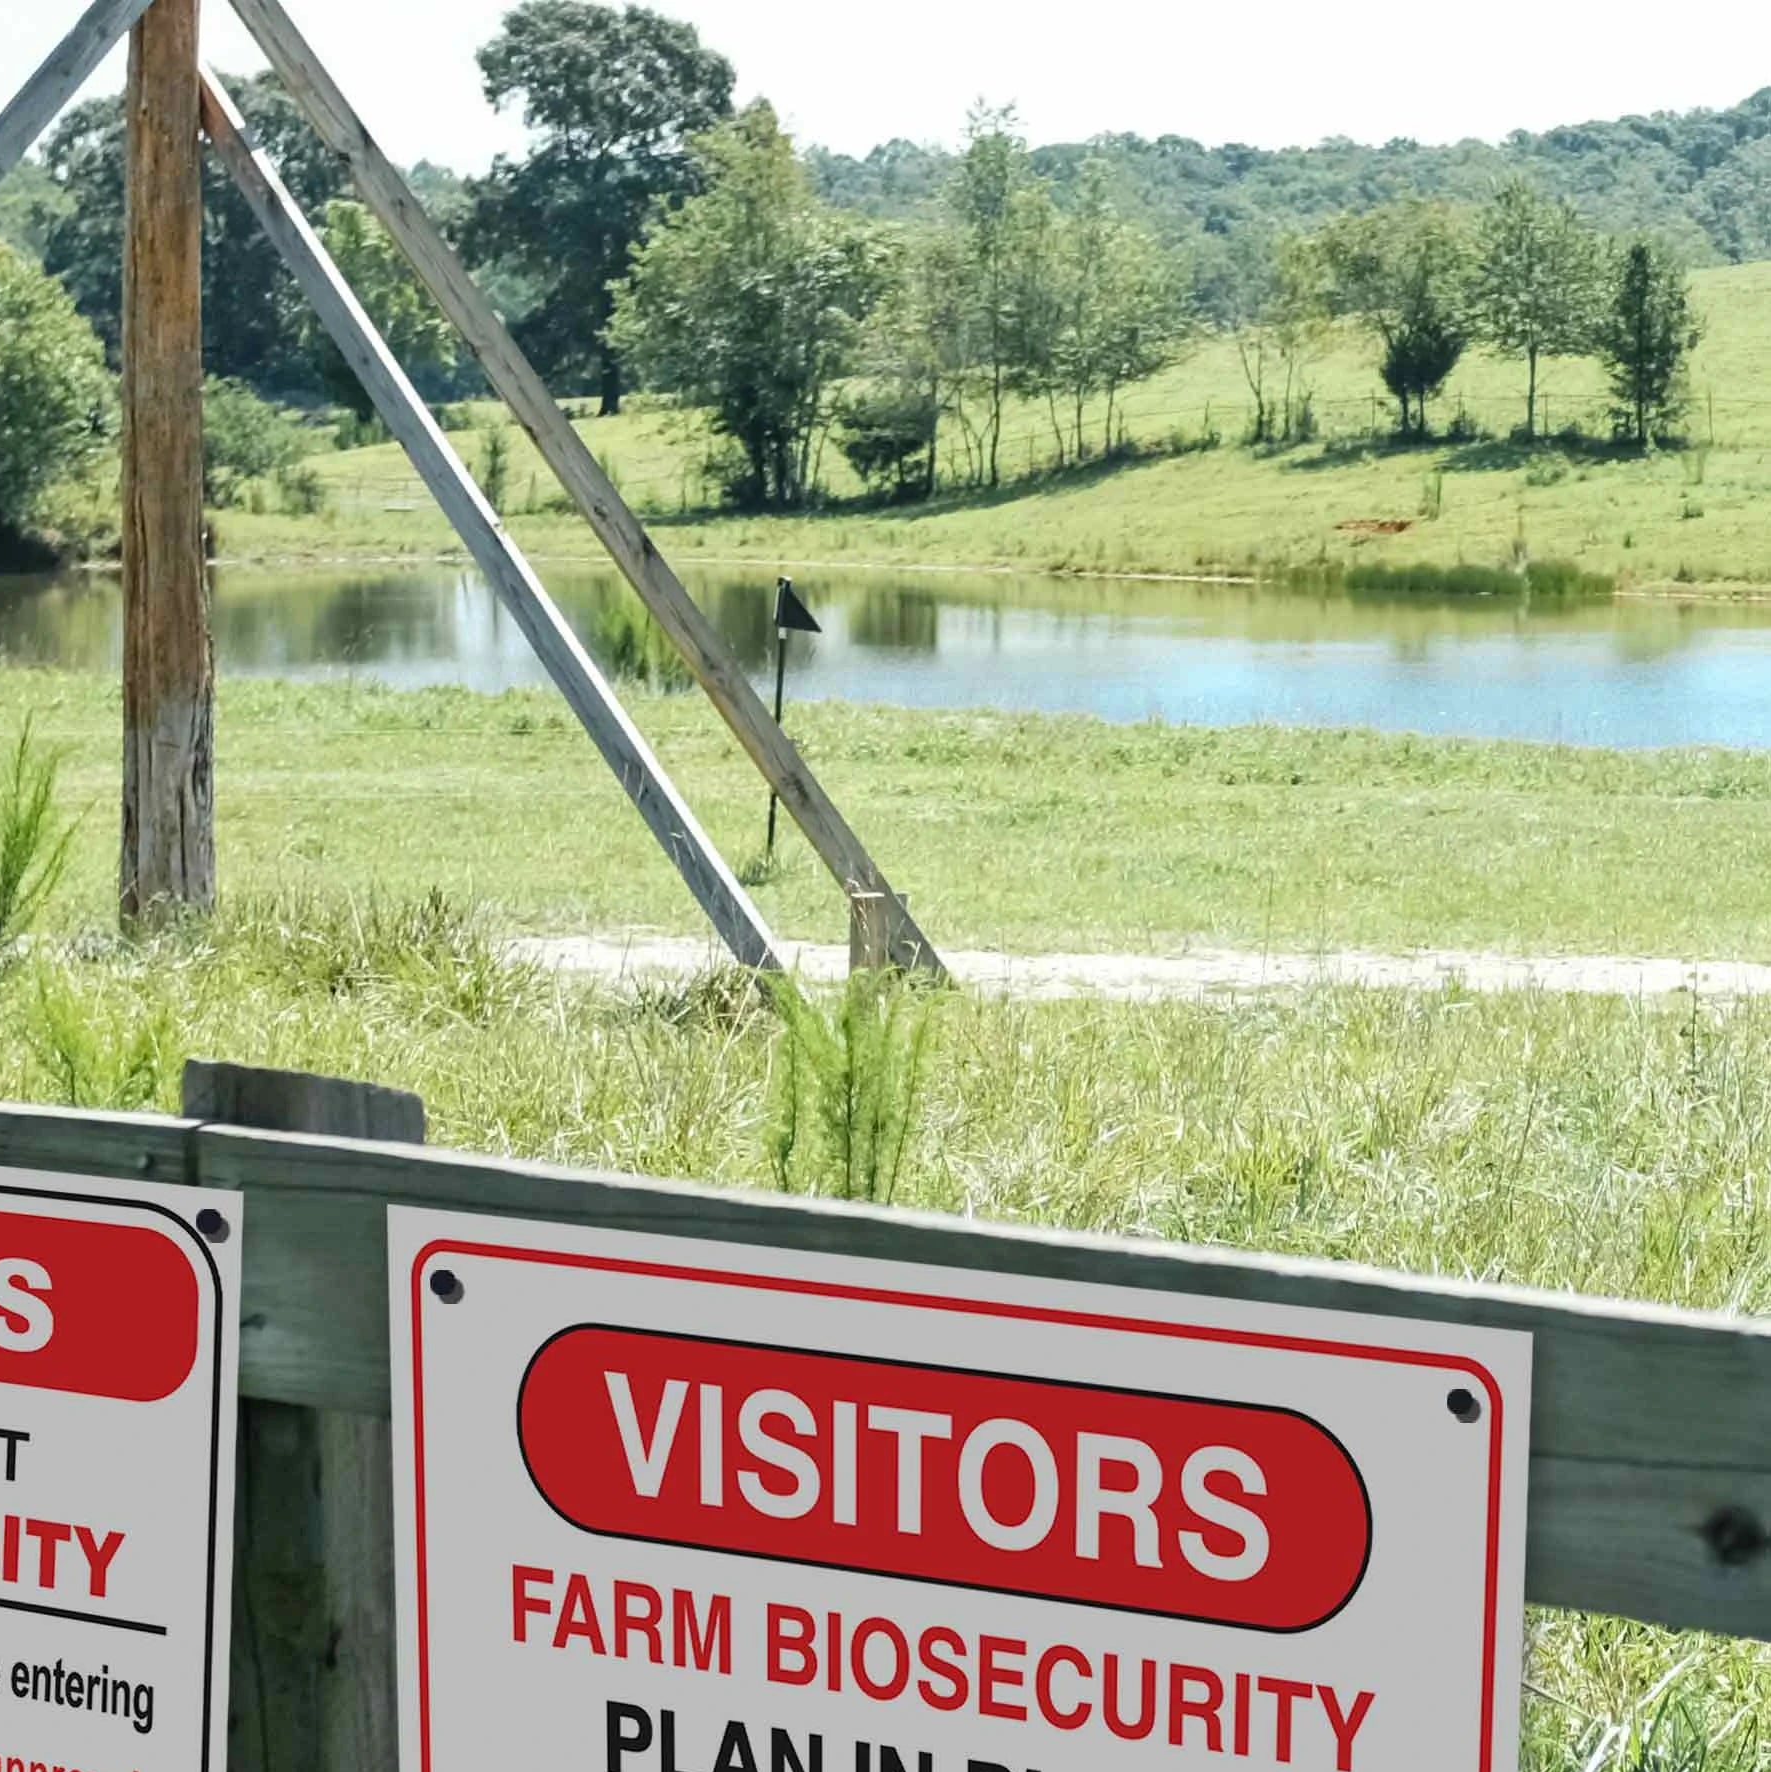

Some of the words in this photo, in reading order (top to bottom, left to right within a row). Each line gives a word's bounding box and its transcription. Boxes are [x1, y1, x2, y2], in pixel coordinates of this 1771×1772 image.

[603, 1371, 1270, 1581] VISITORS
[10, 1658, 154, 1735] entering
[511, 1564, 732, 1676] FARM
[766, 1602, 1375, 1772] BIOSECURITY
